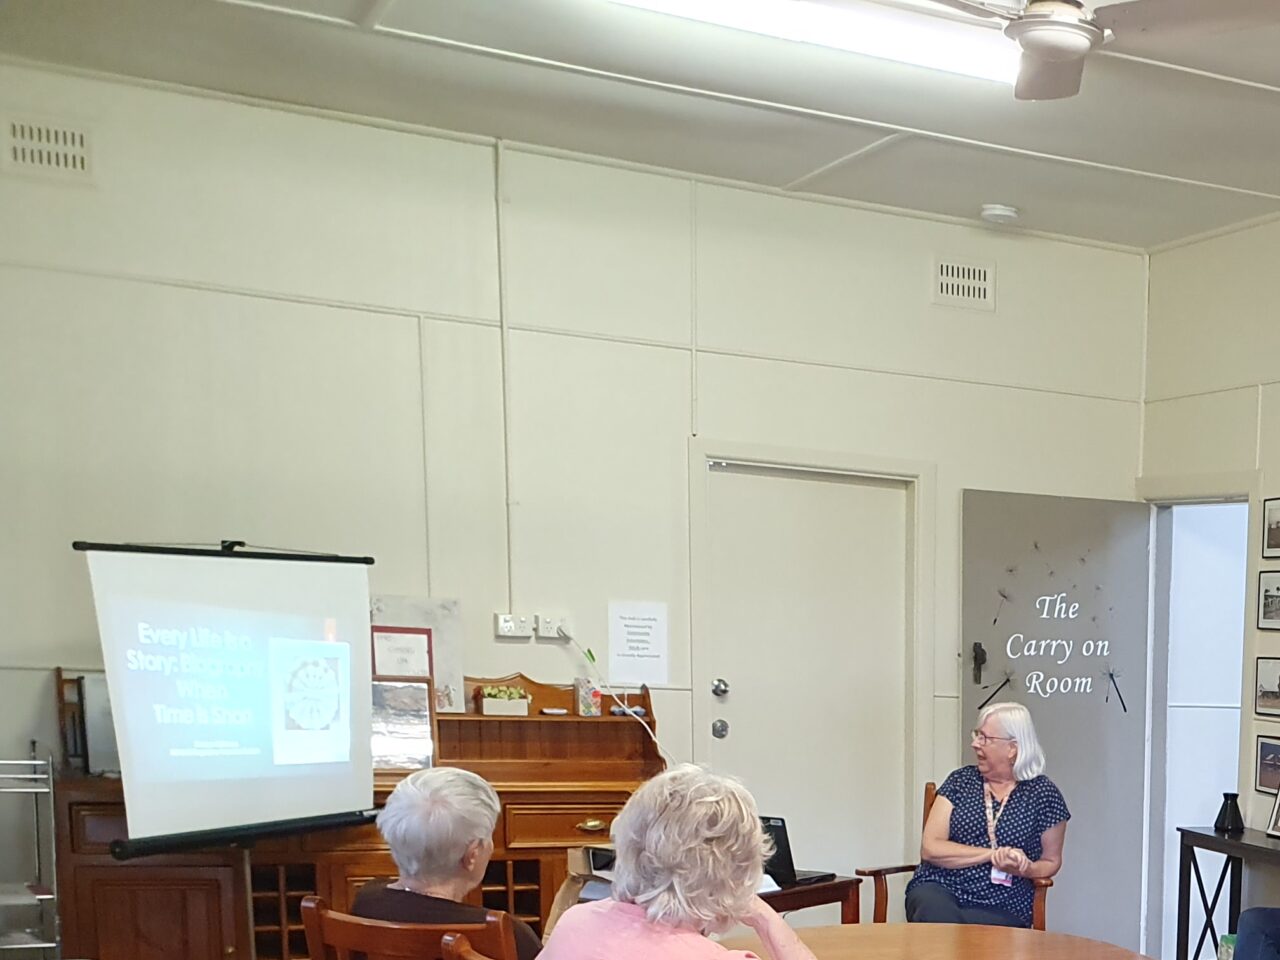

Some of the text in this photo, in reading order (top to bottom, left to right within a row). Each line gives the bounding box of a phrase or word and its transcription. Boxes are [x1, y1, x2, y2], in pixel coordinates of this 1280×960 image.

[1035, 593, 1080, 618] The
[137, 621, 188, 651] Every
[1006, 633, 1111, 664] Carry on
[126, 648, 179, 676] Story:
[1025, 671, 1093, 698] Room
[153, 703, 194, 725] Time
